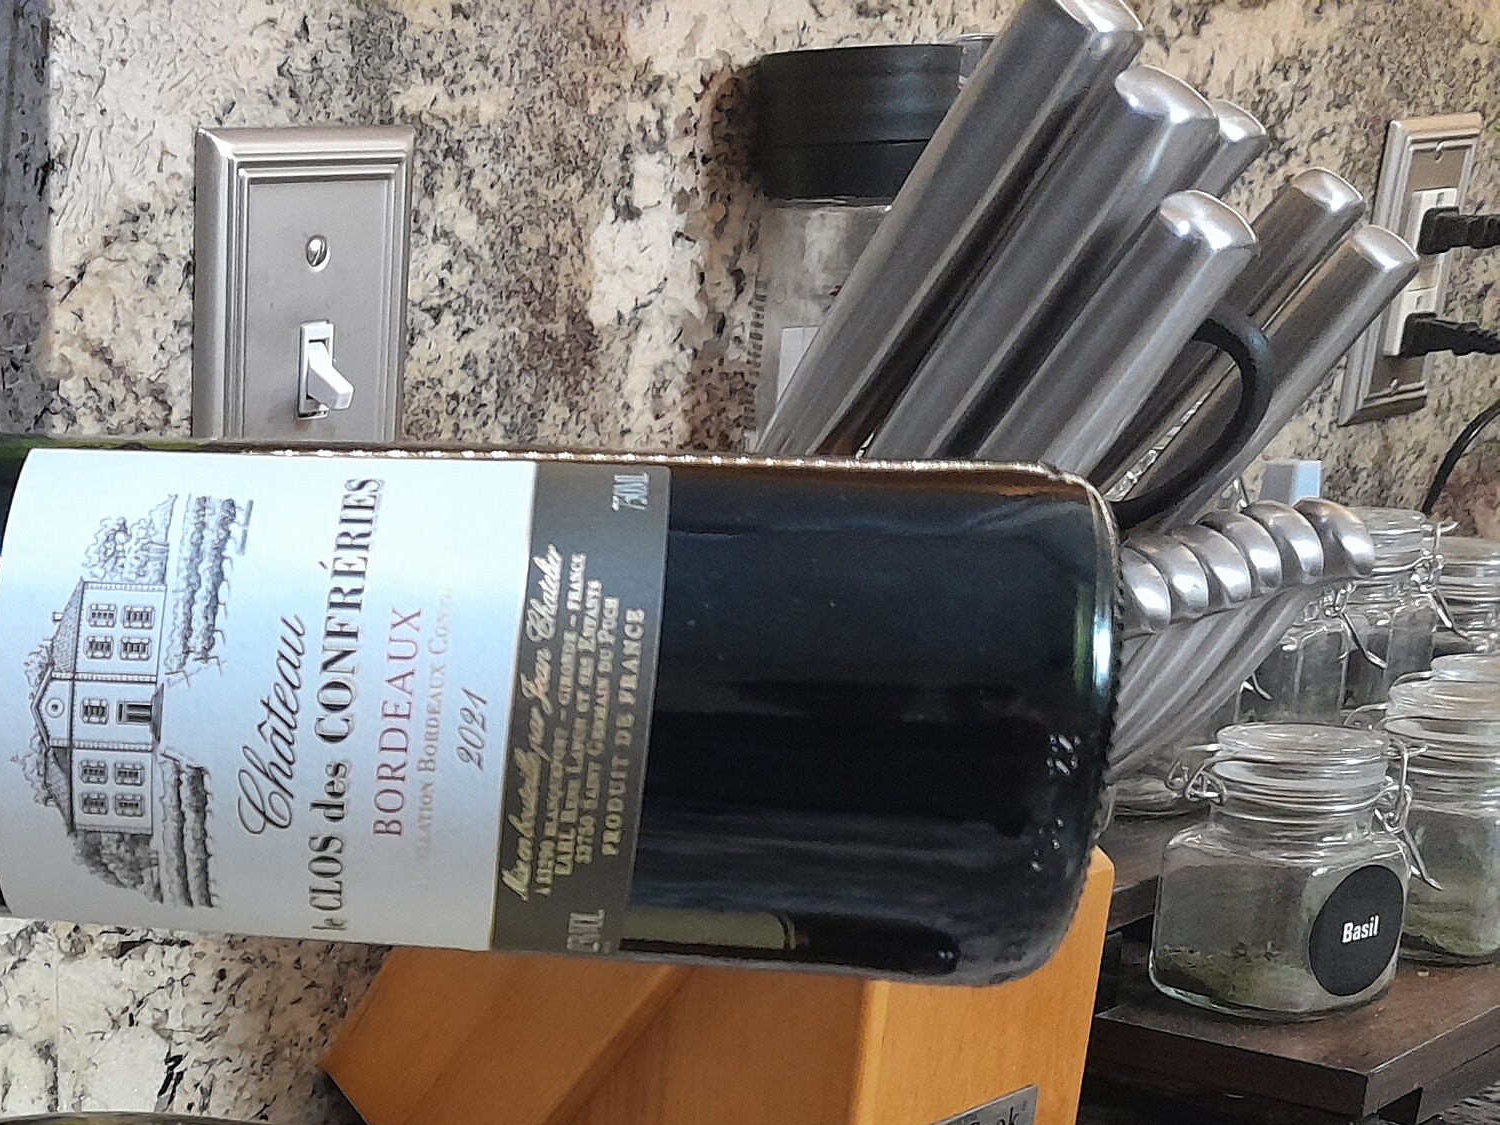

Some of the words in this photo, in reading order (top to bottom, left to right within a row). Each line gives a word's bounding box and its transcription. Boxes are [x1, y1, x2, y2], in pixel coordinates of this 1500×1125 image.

[313, 477, 382, 744] CONFRÉRIES
[566, 553, 586, 611] FRANCE
[520, 648, 553, 715] Jean
[619, 608, 646, 705] FRANCE
[237, 612, 306, 835] Château
[373, 606, 422, 837] BORDEAUX
[418, 662, 446, 774] BORDEAUX
[455, 689, 488, 770] 2021
[613, 714, 634, 746] DE
[310, 762, 349, 823] des
[602, 756, 631, 856] PRODUIT
[309, 835, 346, 912] CLOS
[311, 918, 349, 931] le
[1341, 915, 1380, 945] Basil
